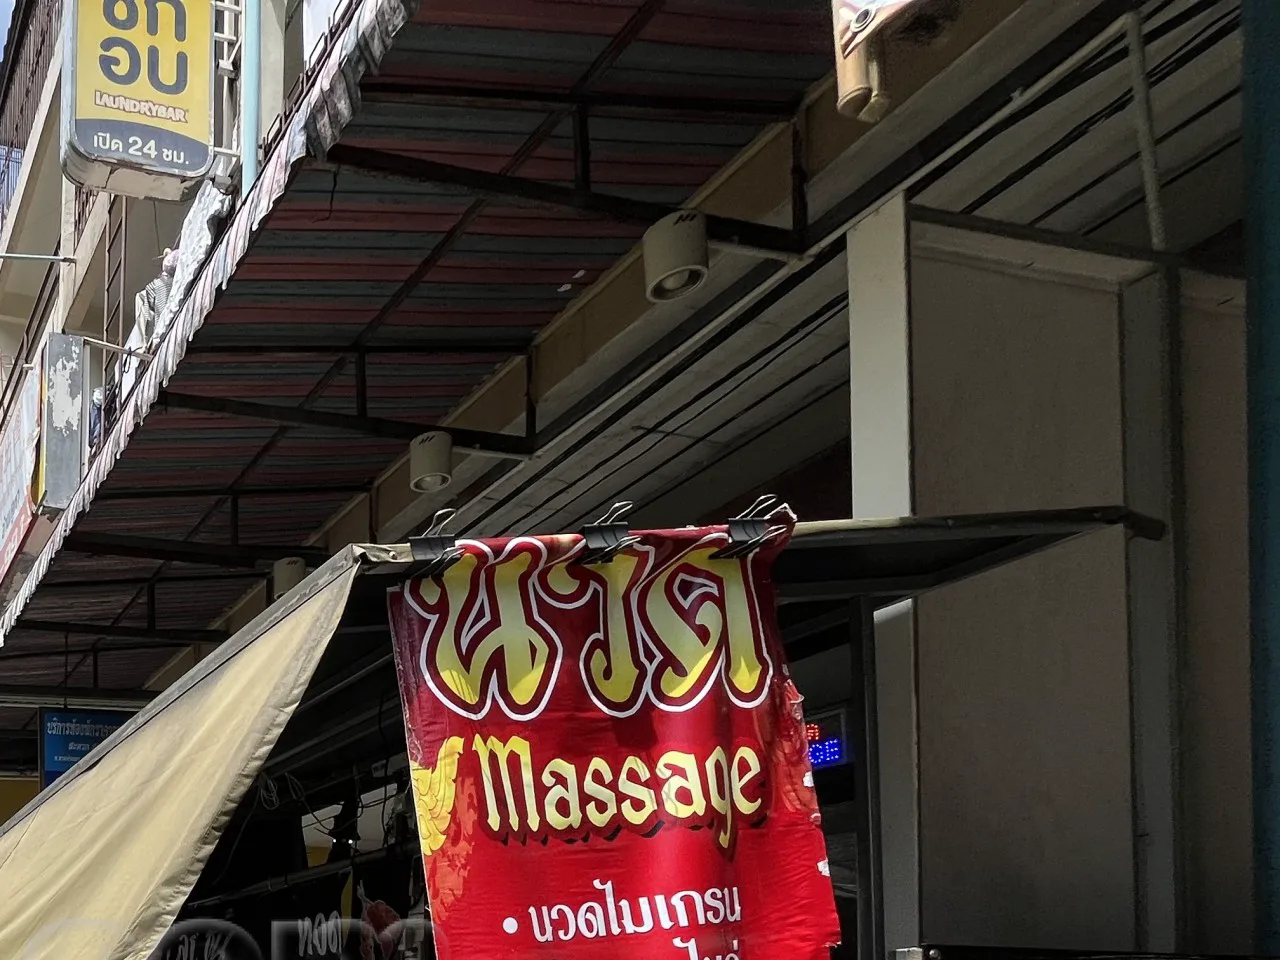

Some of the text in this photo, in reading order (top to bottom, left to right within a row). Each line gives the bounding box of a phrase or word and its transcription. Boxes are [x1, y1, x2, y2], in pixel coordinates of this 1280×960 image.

[99, 36, 188, 95] อบ
[94, 89, 188, 124] LAUNDRYBAR
[93, 131, 190, 165] เปิด 24 ชม.
[404, 534, 773, 721] นวด
[471, 733, 763, 849] Massage
[528, 878, 742, 943] นวดไมเกรน
